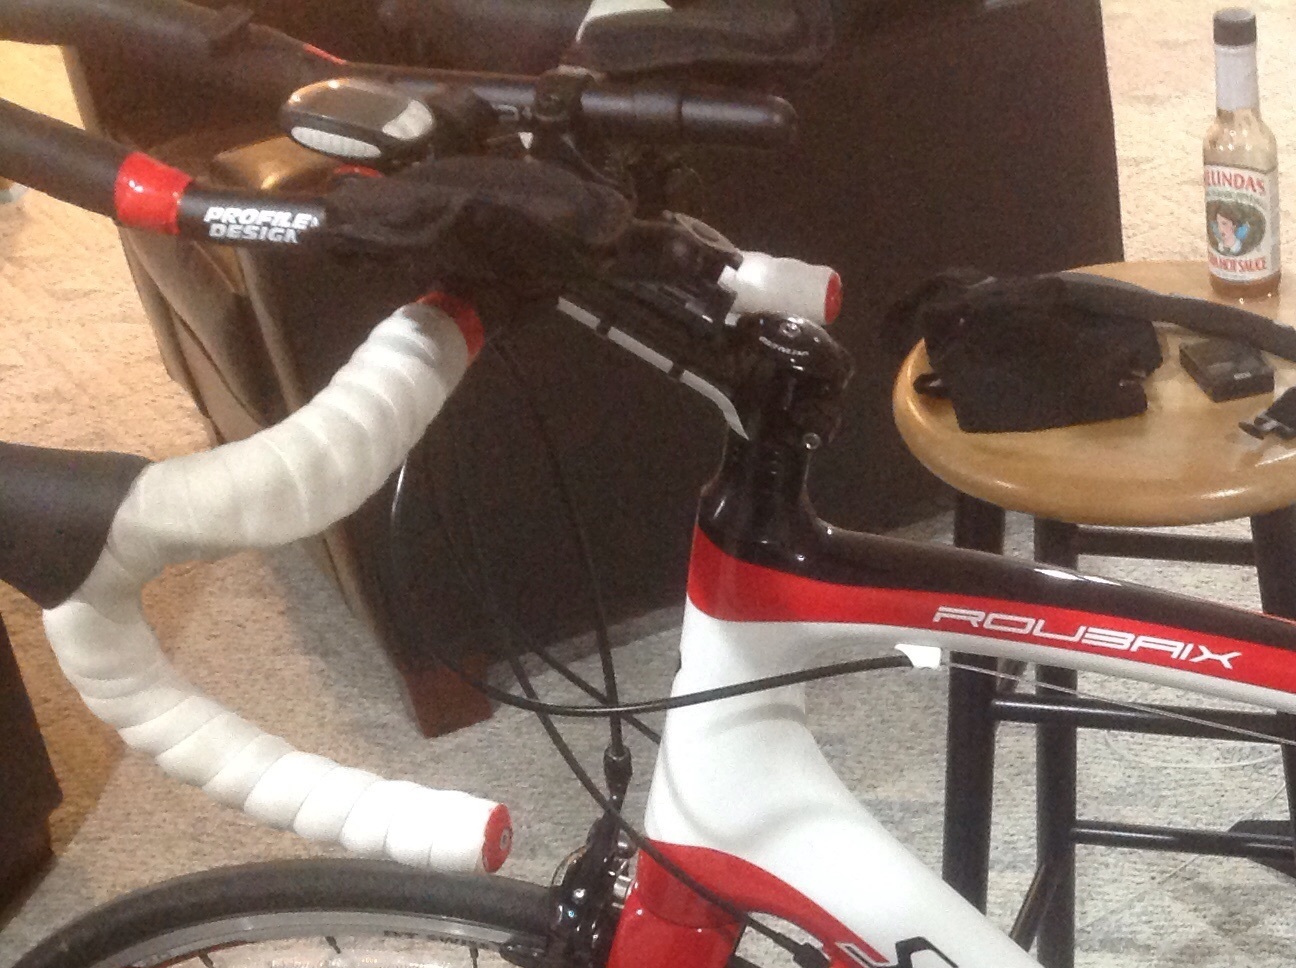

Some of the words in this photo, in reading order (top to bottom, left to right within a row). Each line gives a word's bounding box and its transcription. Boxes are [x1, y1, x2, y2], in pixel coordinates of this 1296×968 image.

[203, 206, 313, 230] PROFILE
[208, 223, 298, 244] DESIGN
[932, 605, 1243, 670] ROUBAIX
